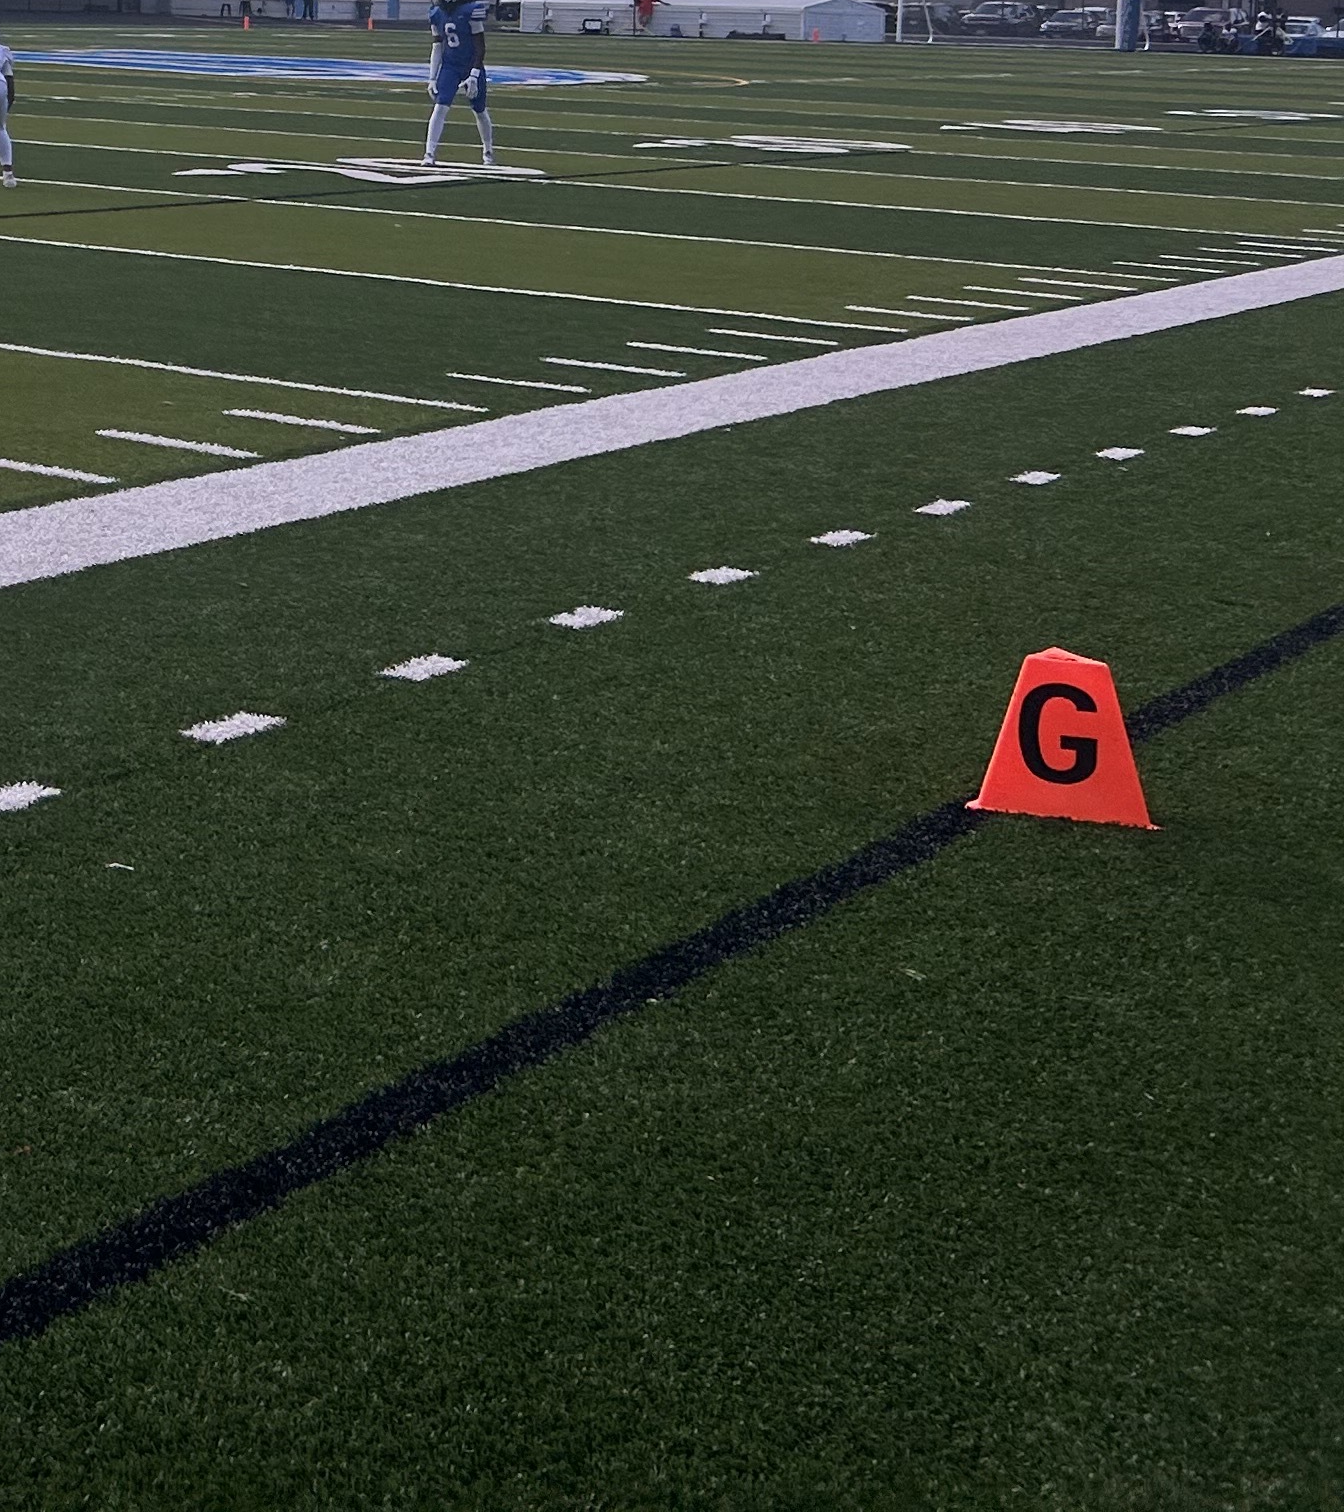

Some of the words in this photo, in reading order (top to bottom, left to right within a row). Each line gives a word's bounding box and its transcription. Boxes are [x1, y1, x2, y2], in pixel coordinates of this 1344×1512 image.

[444, 22, 460, 48] 6
[226, 157, 547, 185] 20
[1018, 683, 1098, 785] G
